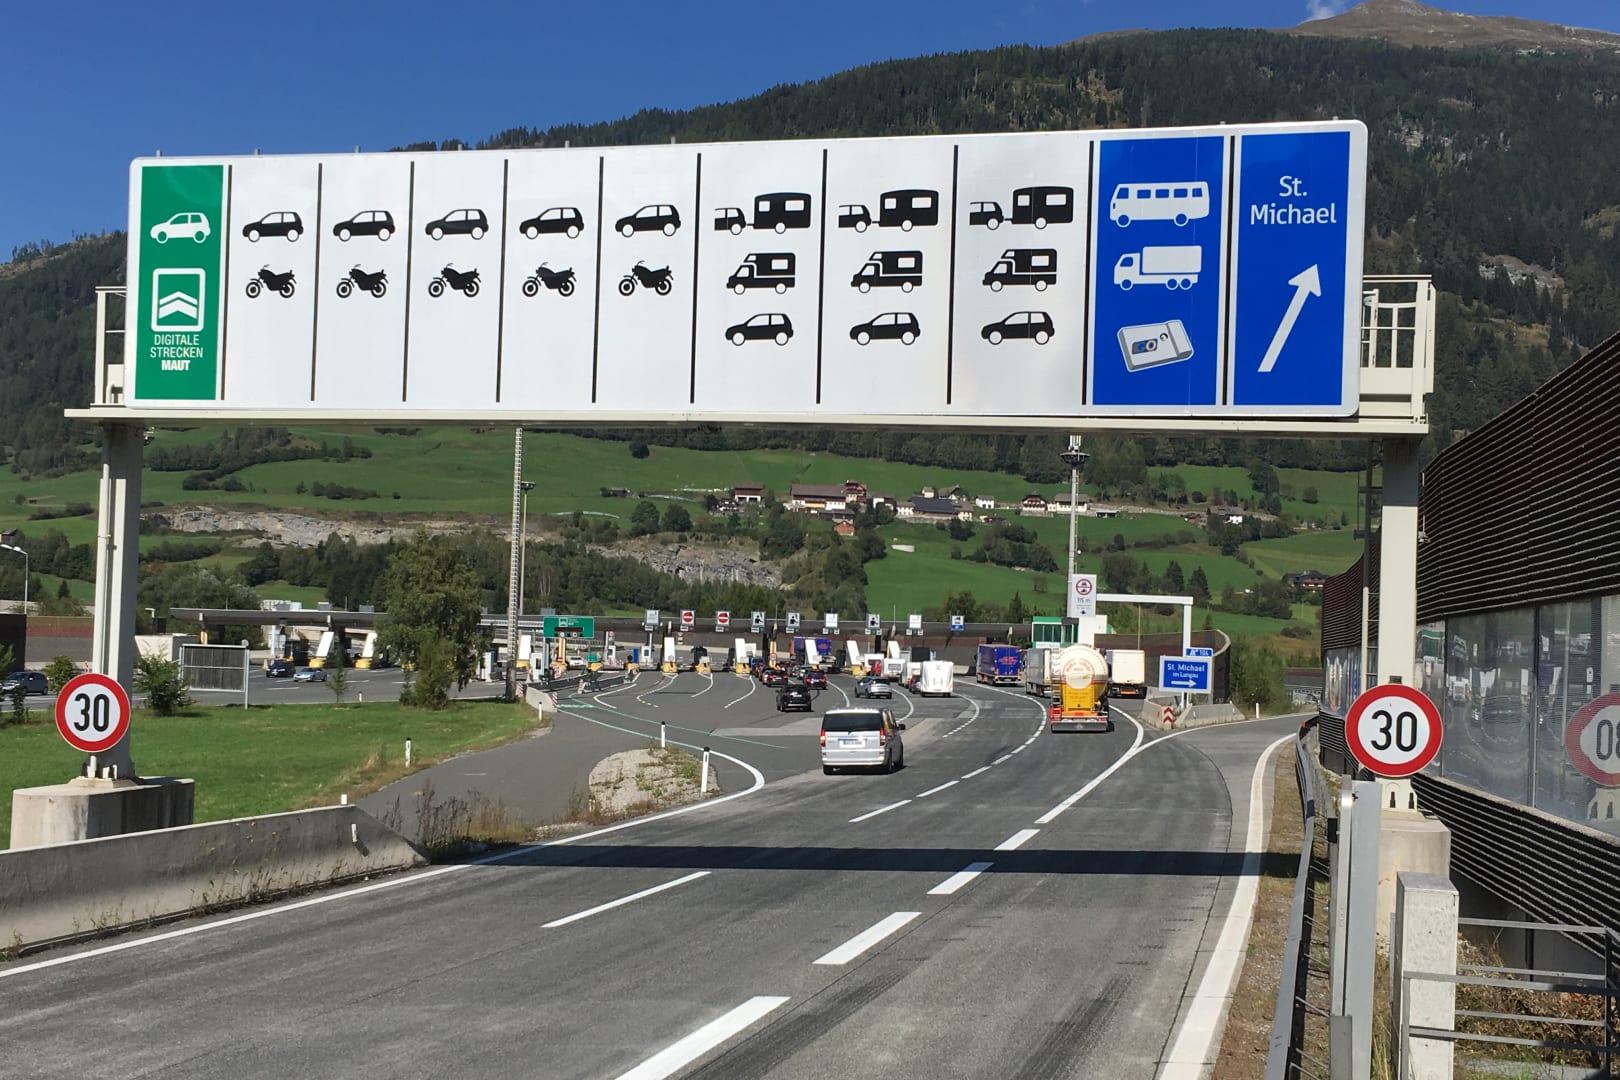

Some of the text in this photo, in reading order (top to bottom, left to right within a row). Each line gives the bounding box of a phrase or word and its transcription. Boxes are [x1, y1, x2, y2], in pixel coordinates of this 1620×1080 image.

[1279, 175, 1308, 197] St.
[1250, 202, 1337, 225] Michael
[154, 334, 200, 346] DIGITALE
[150, 346, 204, 358] STRECKEN
[161, 359, 191, 371] MAUT
[1167, 663, 1205, 672] St. Michael
[73, 693, 110, 732] 30
[1371, 709, 1418, 752] 30
